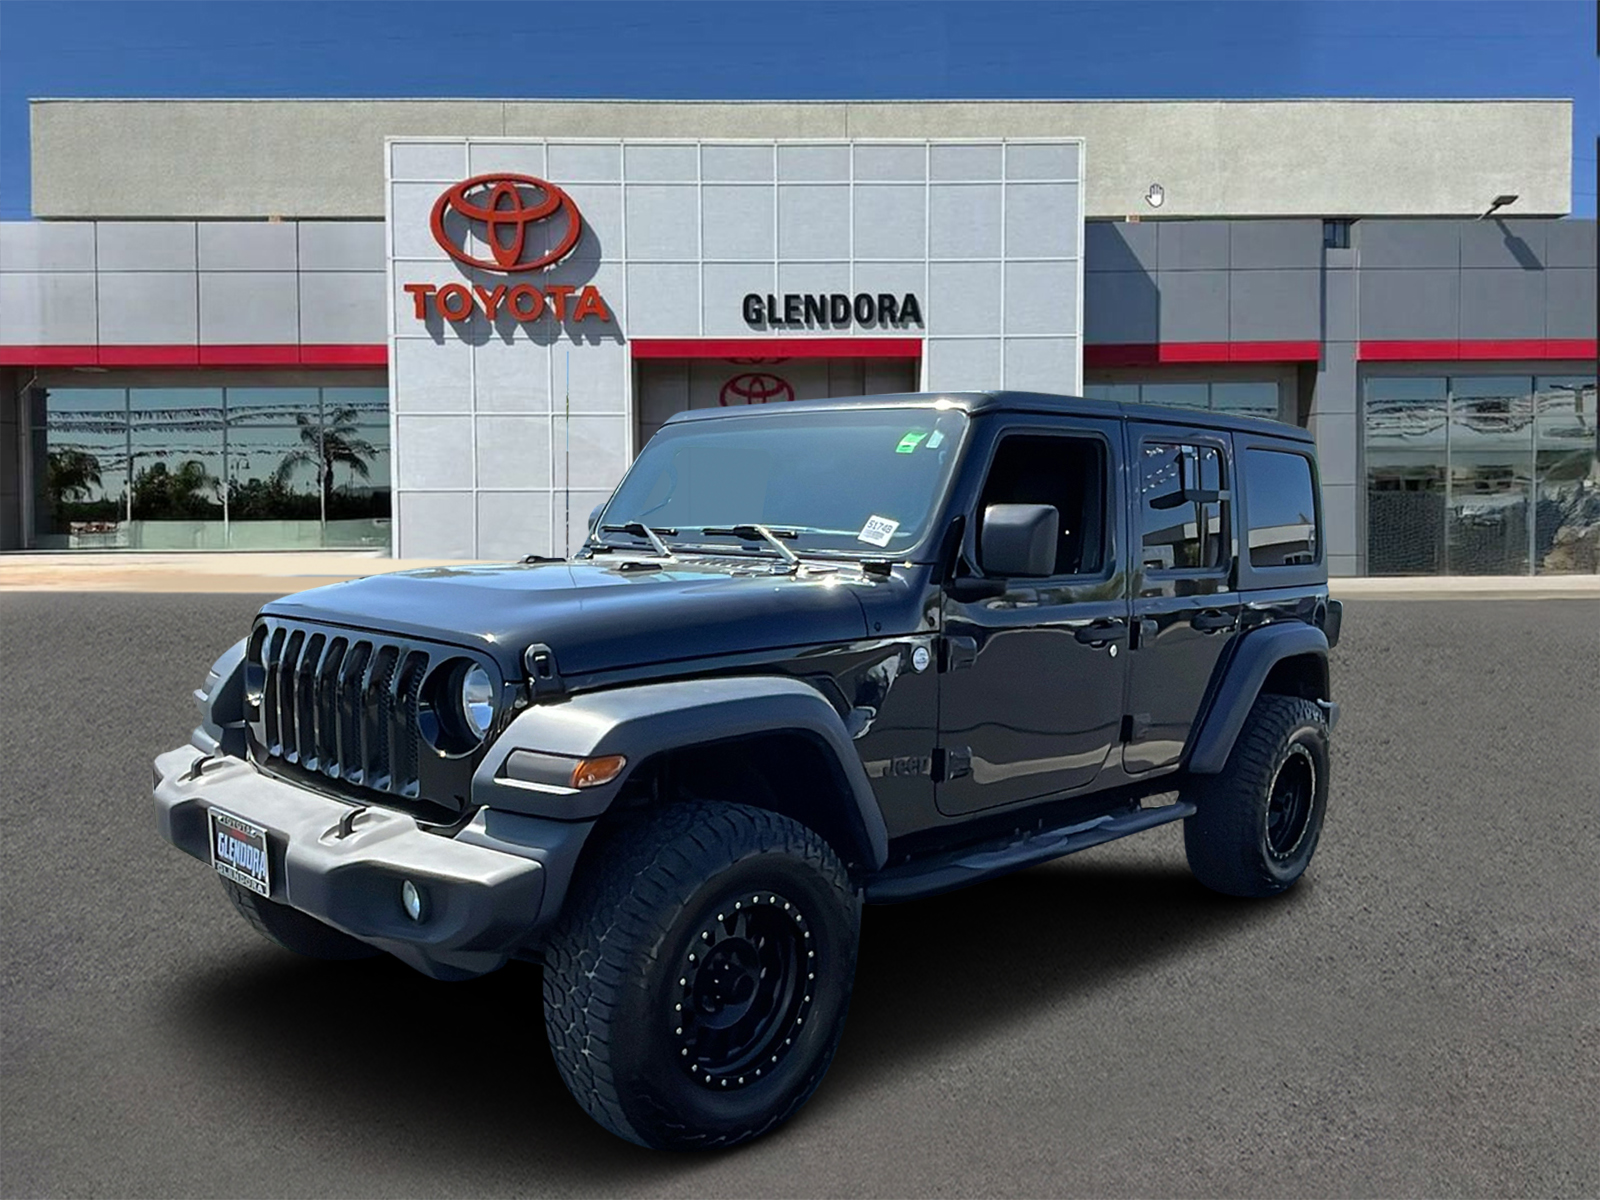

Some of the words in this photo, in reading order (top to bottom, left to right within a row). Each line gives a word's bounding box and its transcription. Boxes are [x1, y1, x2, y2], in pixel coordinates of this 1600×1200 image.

[404, 283, 609, 323] TOYOTA
[742, 293, 922, 325] GLENDORA
[218, 832, 266, 879] GLENDORA
[216, 862, 263, 893] GLENDORA
